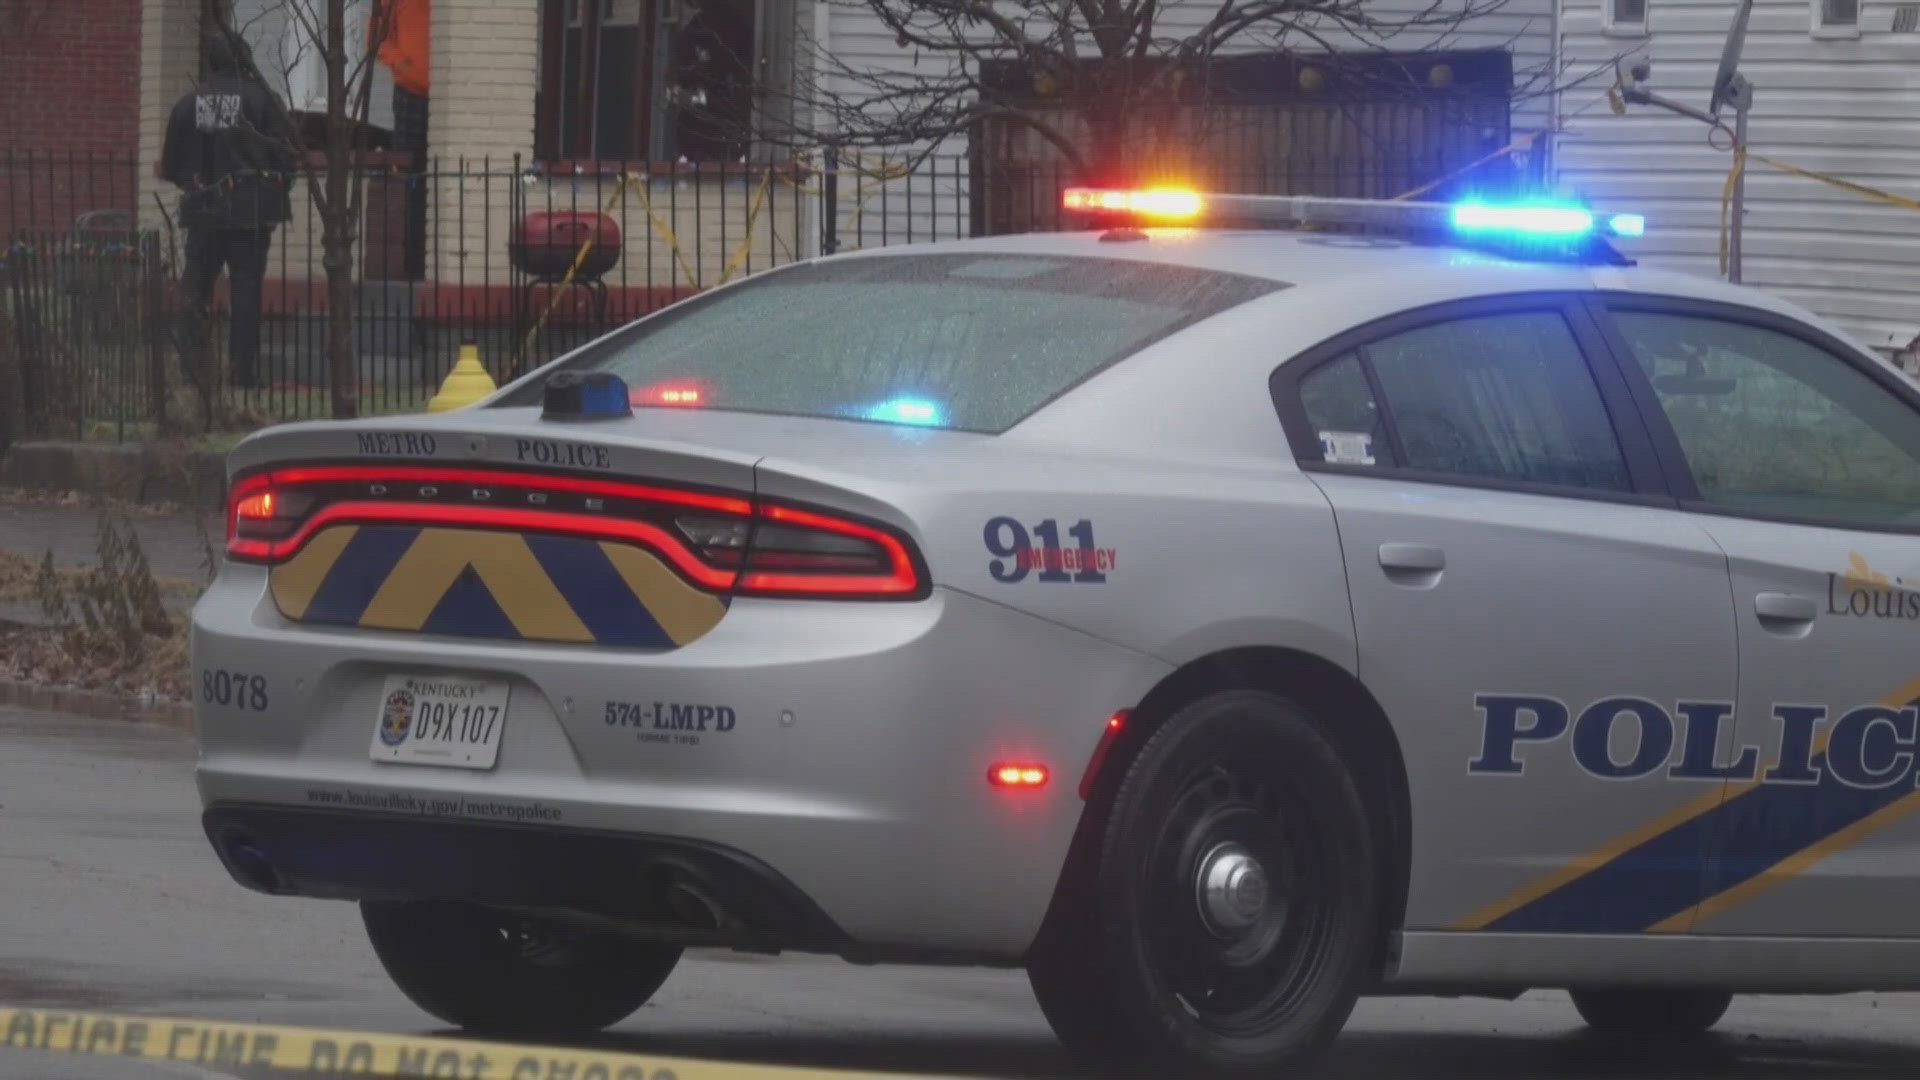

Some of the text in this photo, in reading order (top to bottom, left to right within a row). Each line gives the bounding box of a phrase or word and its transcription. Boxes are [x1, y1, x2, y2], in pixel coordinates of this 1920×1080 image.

[356, 432, 611, 470] METRO POLICE
[370, 483, 605, 511] DODGE
[983, 516, 1107, 584] 911
[1016, 546, 1117, 571] EMERGENCY
[1825, 571, 1920, 620] Louis
[203, 669, 269, 711] 8078
[413, 681, 477, 699] KENTUCKY
[415, 701, 500, 745] D9X107
[605, 700, 737, 732] 574-LMPD
[1467, 692, 1920, 790] POLIC
